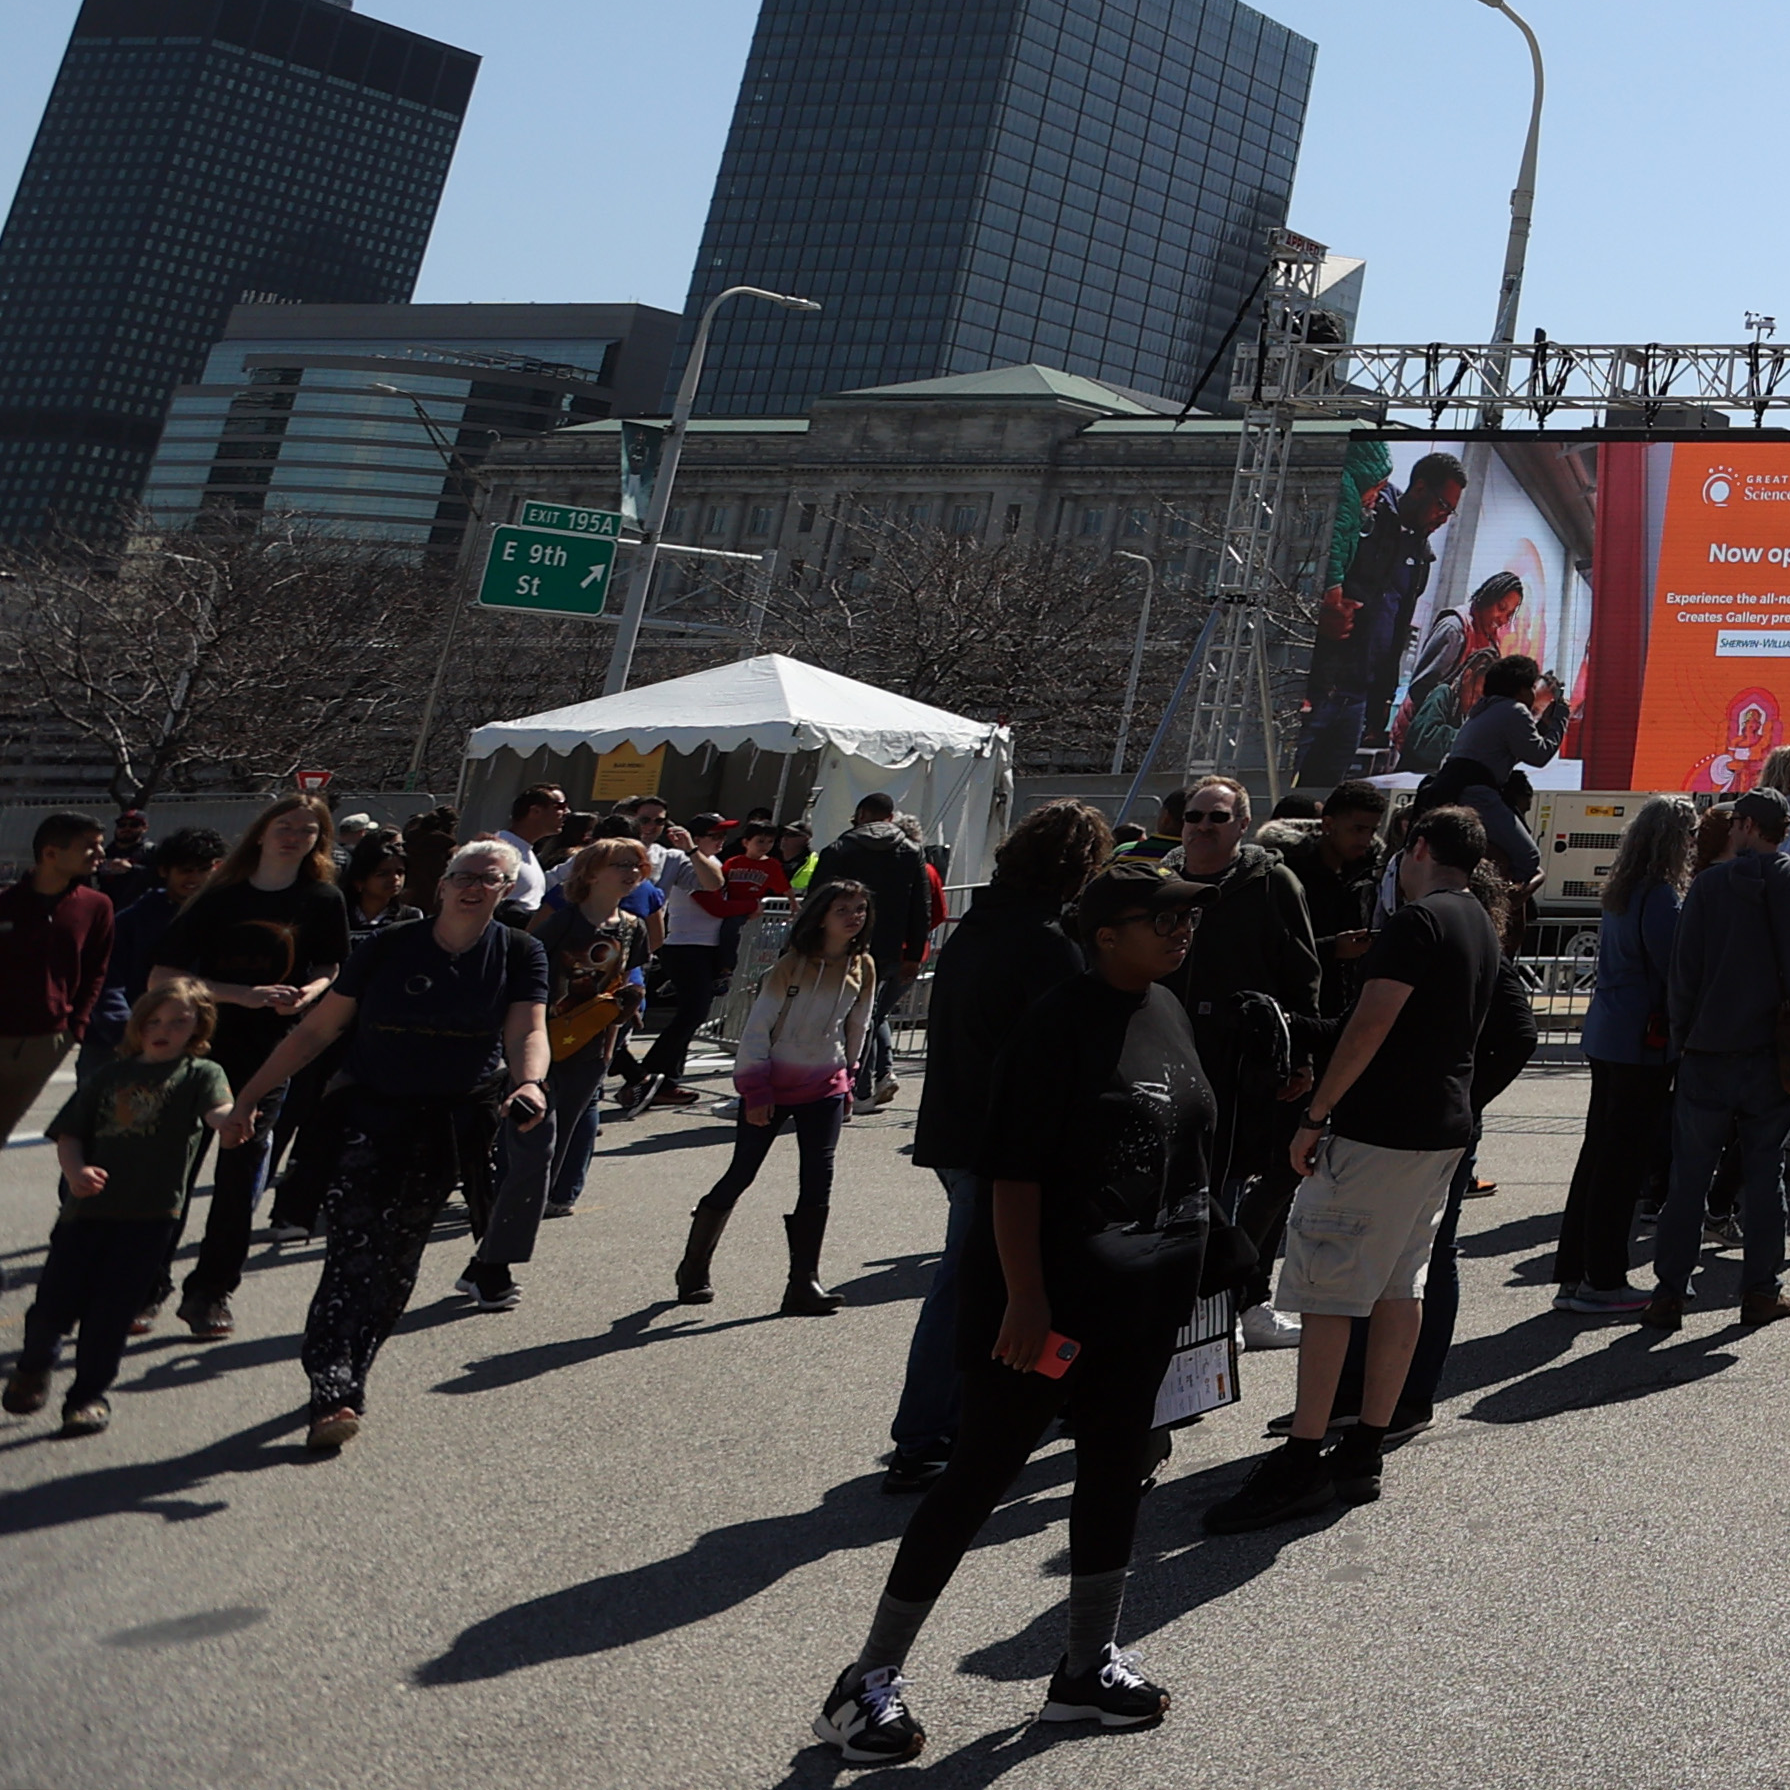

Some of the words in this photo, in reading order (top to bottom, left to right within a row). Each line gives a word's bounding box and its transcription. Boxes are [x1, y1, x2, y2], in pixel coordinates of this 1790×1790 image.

[529, 509, 560, 523] EXIT
[568, 512, 612, 534] 195A
[503, 542, 517, 560] E
[529, 544, 567, 566] 9th
[1709, 543, 1762, 563] Now
[516, 575, 541, 596] St
[1666, 593, 1732, 605] Experience
[1737, 593, 1756, 604] the
[1677, 612, 1722, 623] Creates
[1726, 612, 1768, 625] Gallery
